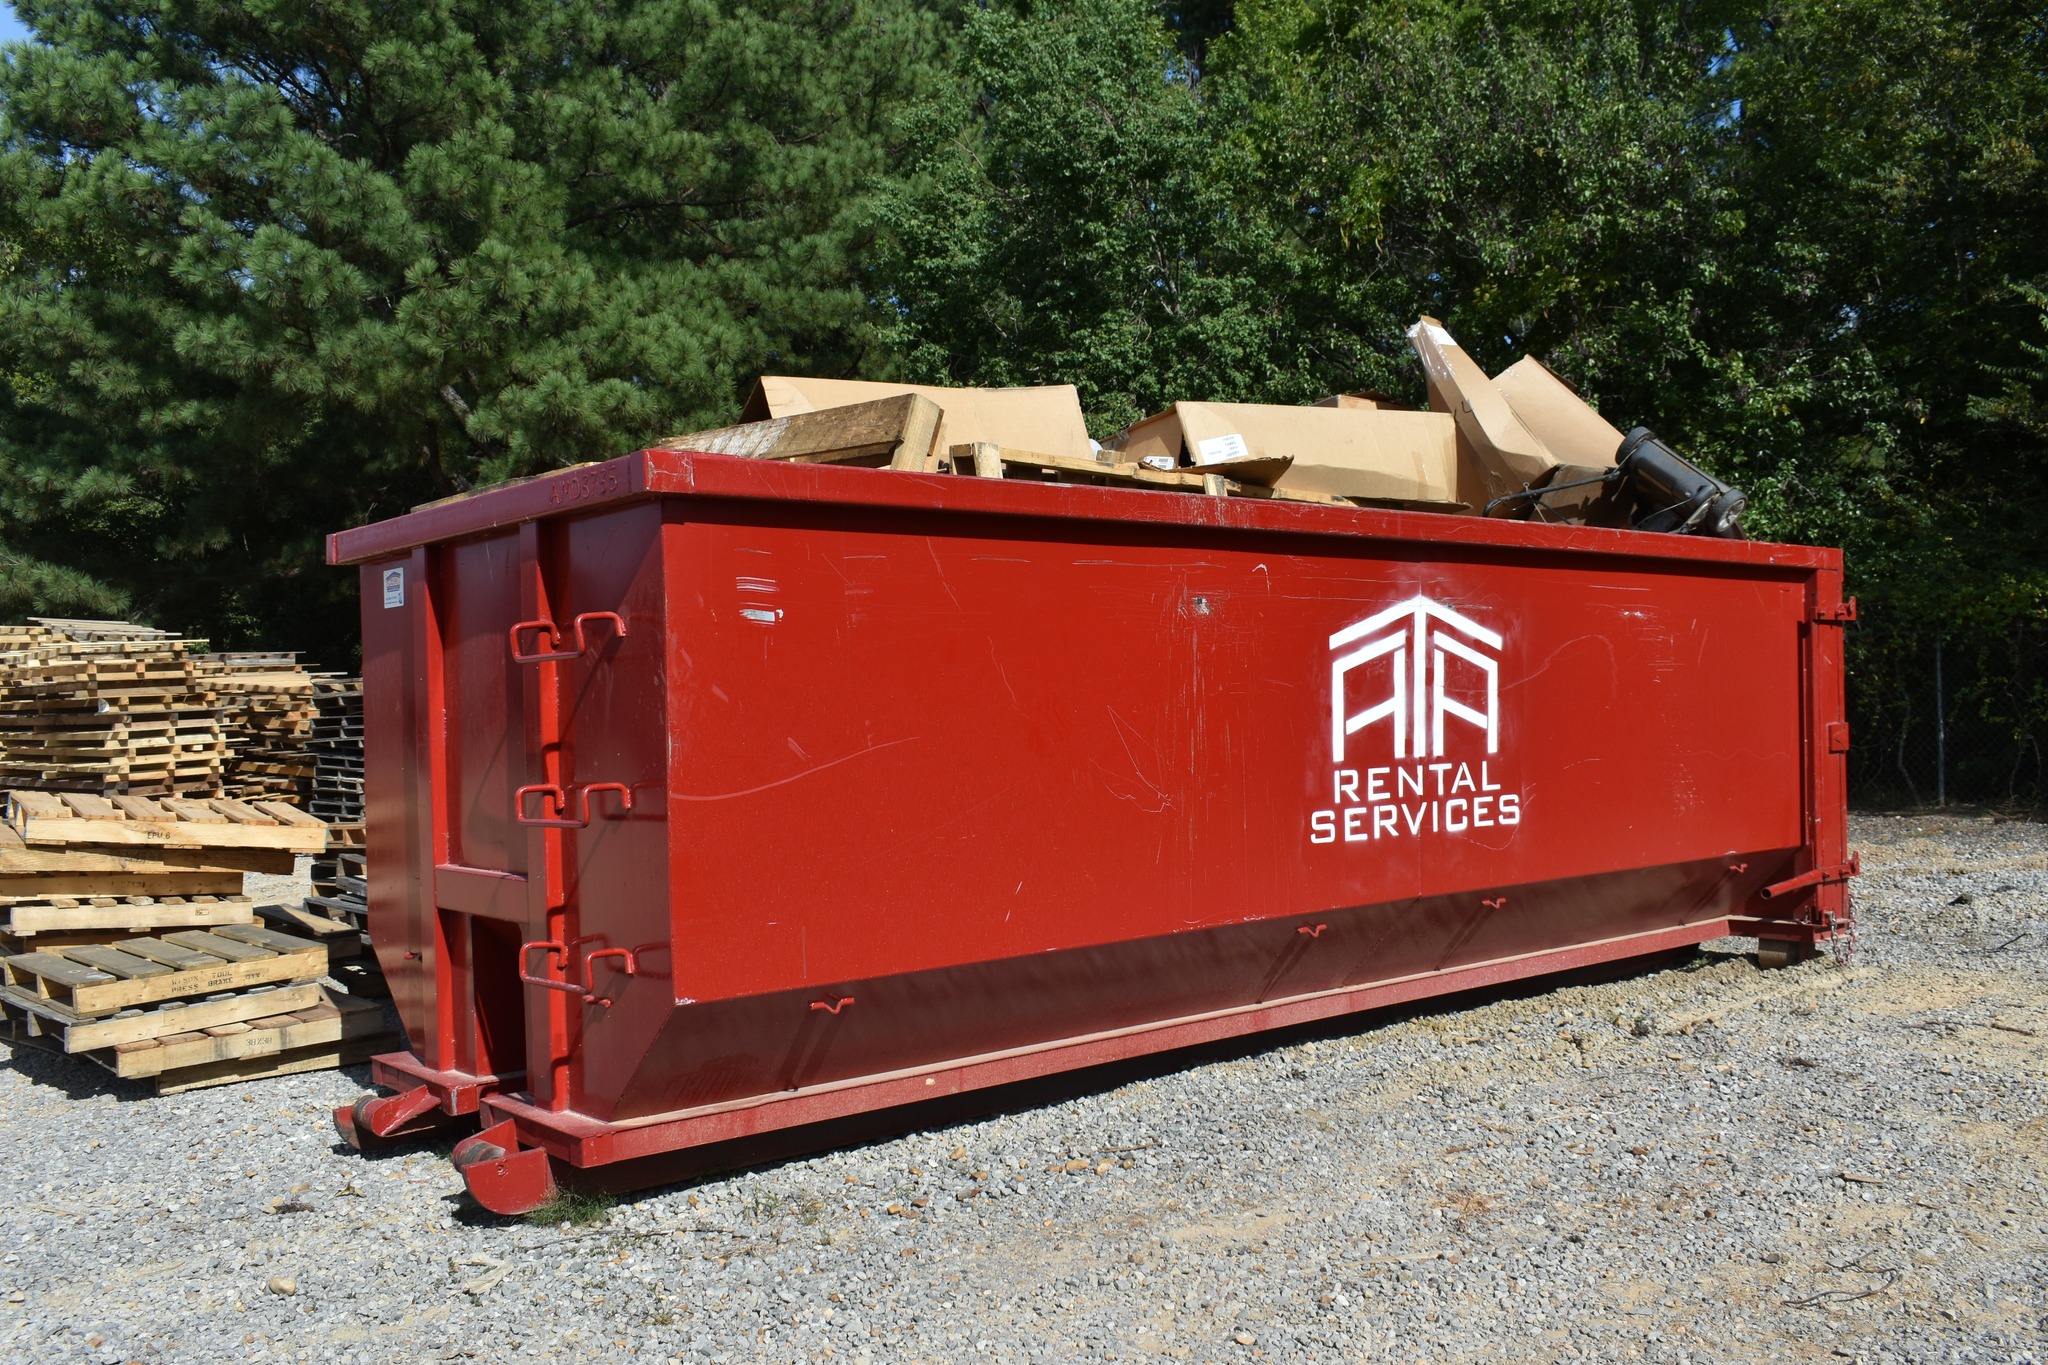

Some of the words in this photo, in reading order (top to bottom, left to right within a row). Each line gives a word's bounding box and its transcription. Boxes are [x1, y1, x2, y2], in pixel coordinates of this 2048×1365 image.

[1333, 760, 1501, 804] RENTAL
[1310, 793, 1521, 844] SERVICES
[171, 983, 199, 993] PRESS
[207, 976, 234, 987] BRAKE
